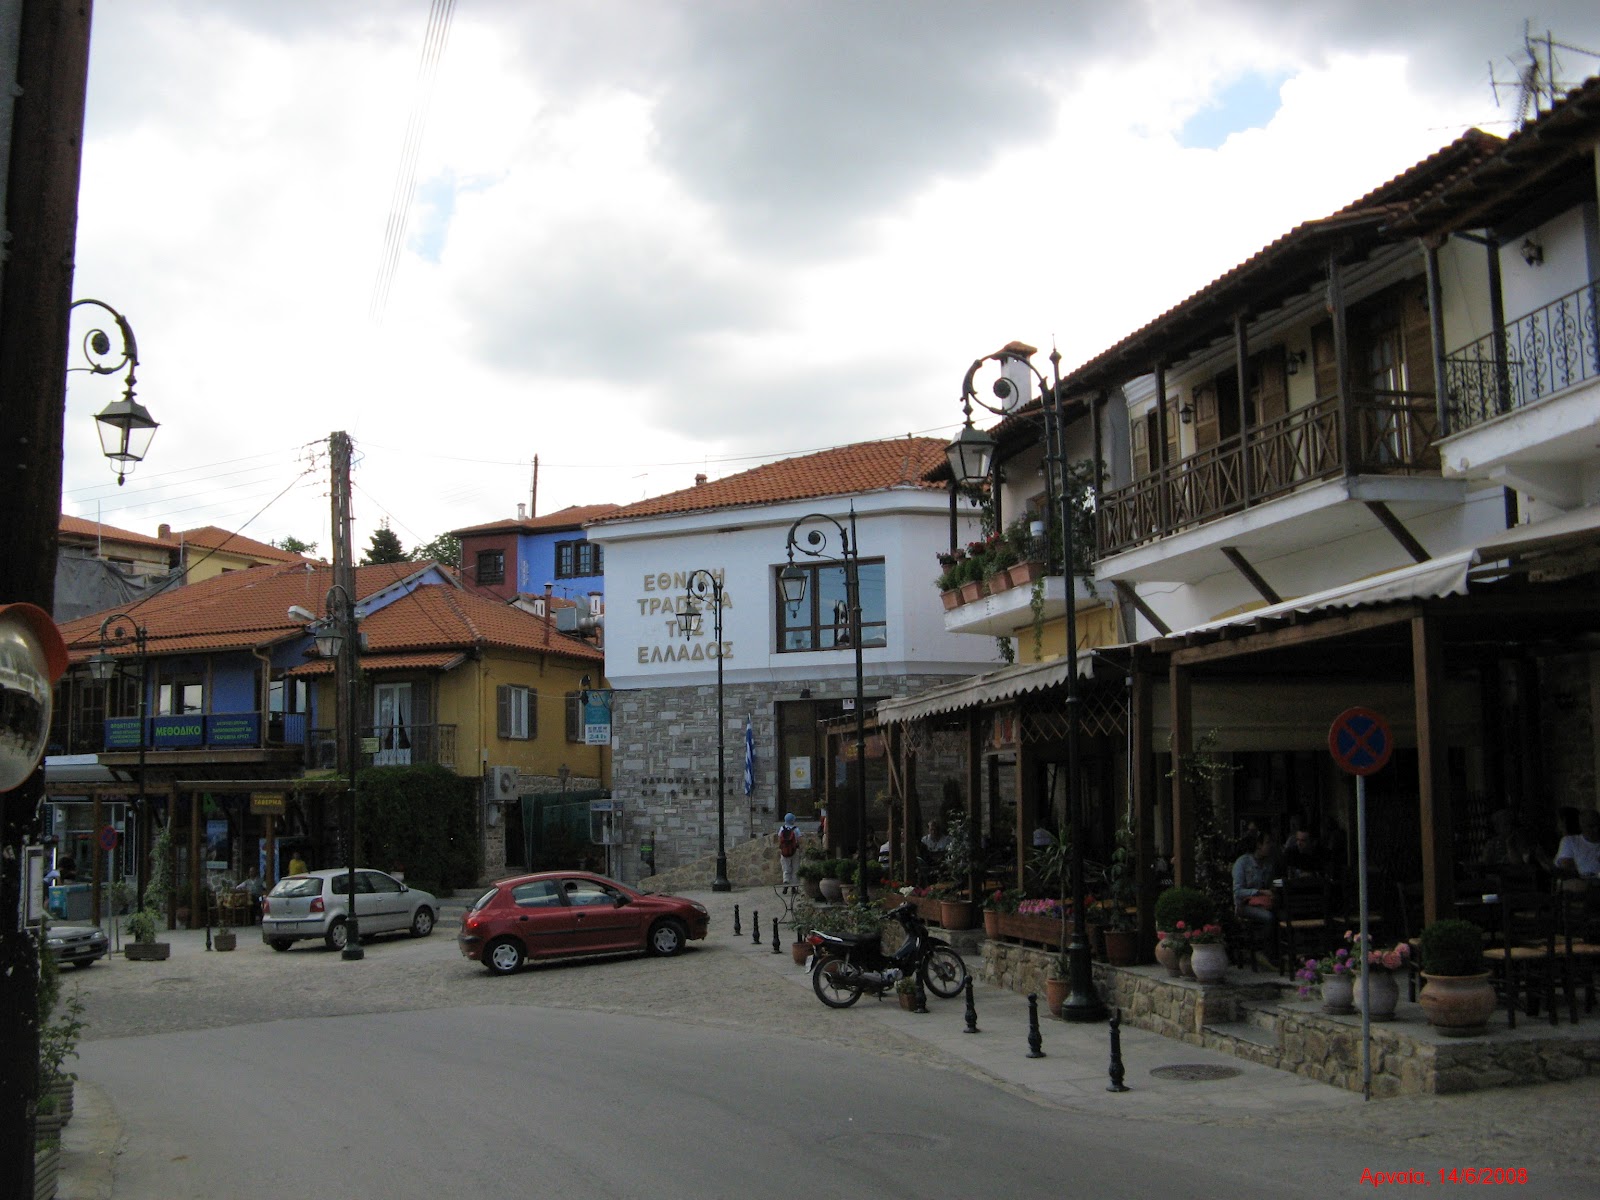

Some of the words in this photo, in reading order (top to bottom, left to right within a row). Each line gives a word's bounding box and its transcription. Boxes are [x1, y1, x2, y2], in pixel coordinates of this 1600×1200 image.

[643, 567, 725, 592] ΕΘΝΚΗ
[637, 592, 733, 616] ΤΡΑΠΕΖΑ
[637, 641, 734, 664] ΕΛΛΑΔΟΣ
[155, 725, 201, 737] ΜΕΘΟΔΙΚΟ
[641, 777, 697, 785] NATIONAL
